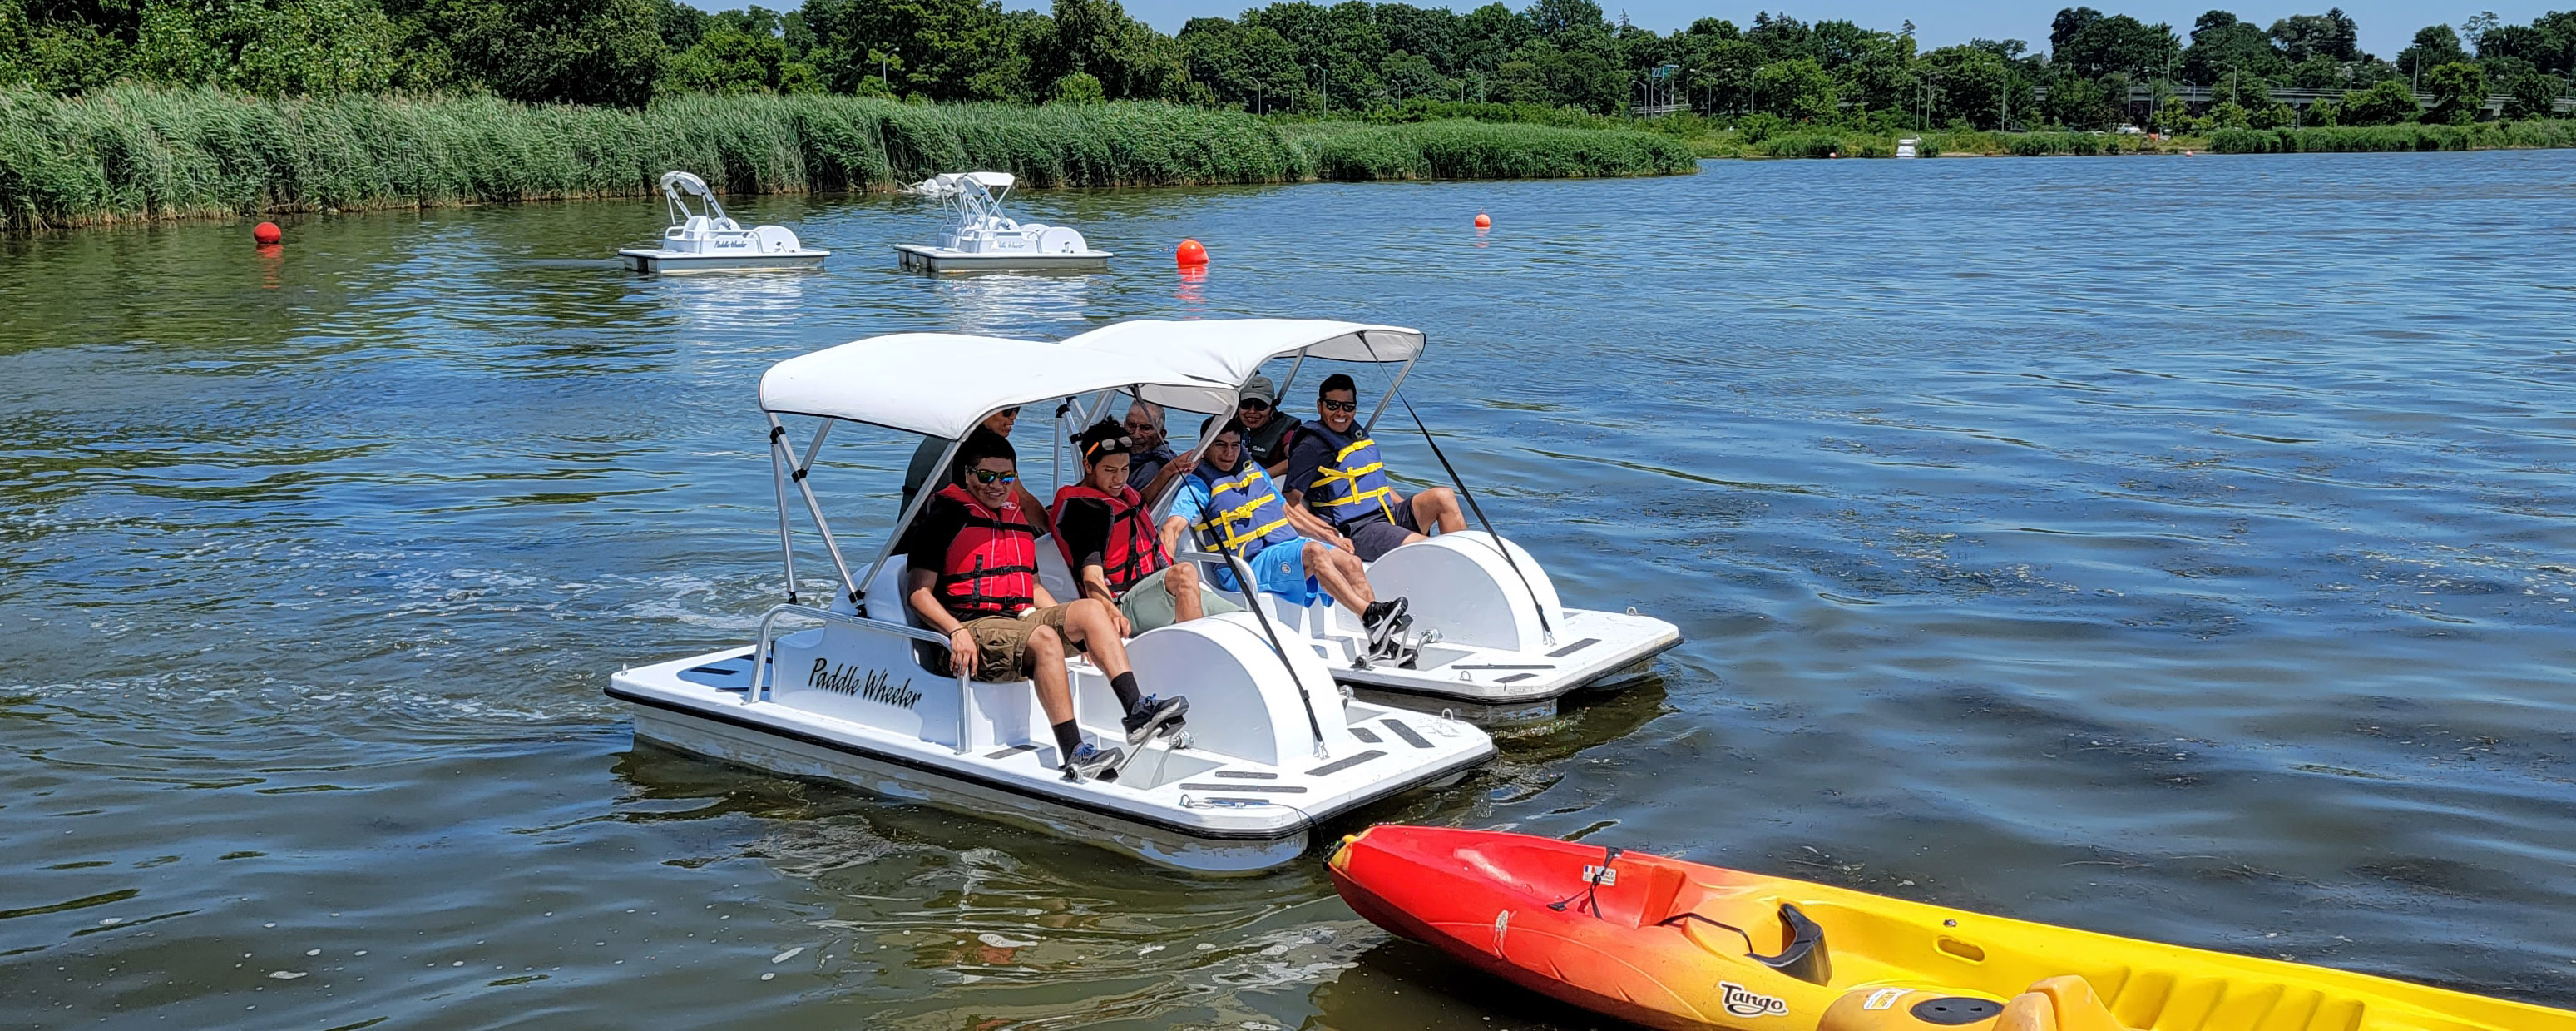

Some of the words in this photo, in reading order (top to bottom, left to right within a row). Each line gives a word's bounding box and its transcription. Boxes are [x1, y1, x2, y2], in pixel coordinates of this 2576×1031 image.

[808, 657, 861, 696] Paddle
[863, 668, 922, 710] Wheeler
[1721, 983, 1786, 1015] Tango
